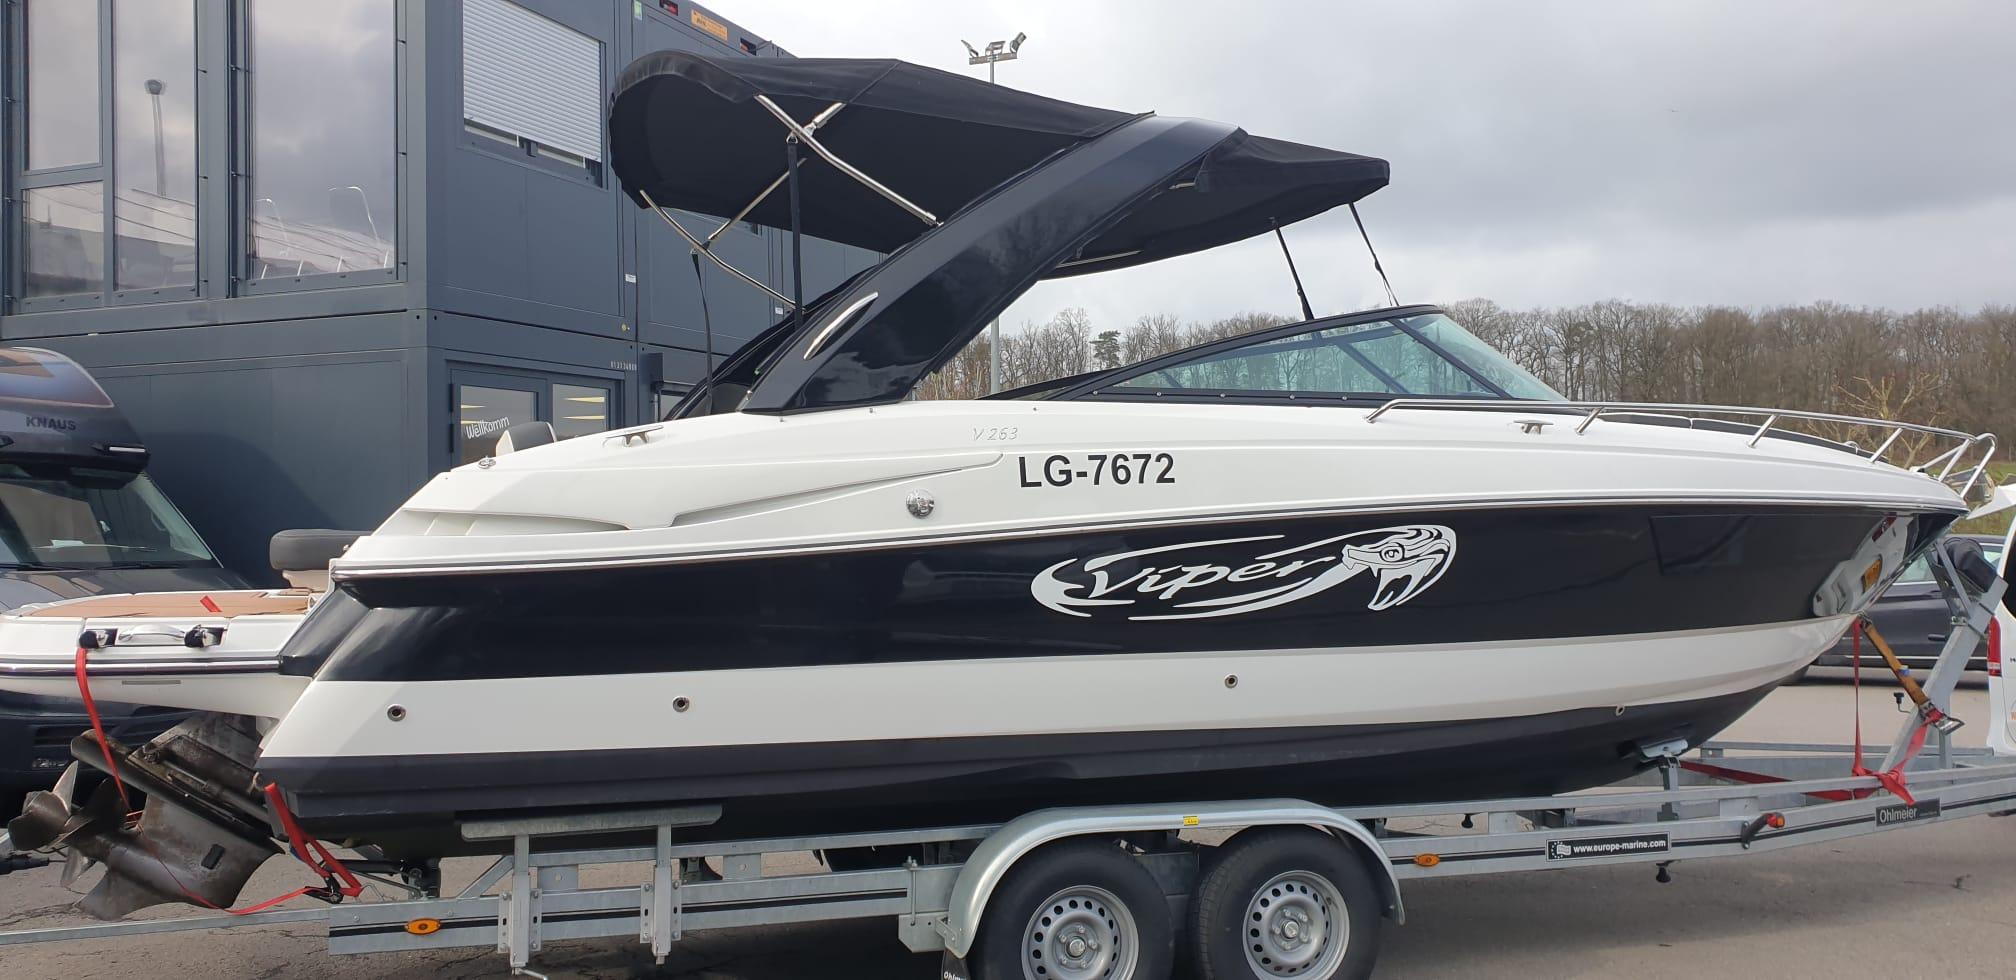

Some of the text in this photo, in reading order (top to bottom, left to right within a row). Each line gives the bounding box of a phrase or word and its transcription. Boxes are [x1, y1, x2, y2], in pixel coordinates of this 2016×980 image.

[26, 416, 77, 431] KNAUS
[986, 427, 1018, 441] 263
[1018, 452, 1176, 488] LG-7672
[1088, 556, 1337, 600] Viper
[1879, 807, 1918, 823] Ohlmeier
[1573, 839, 1667, 854] www.europe-marine.com
